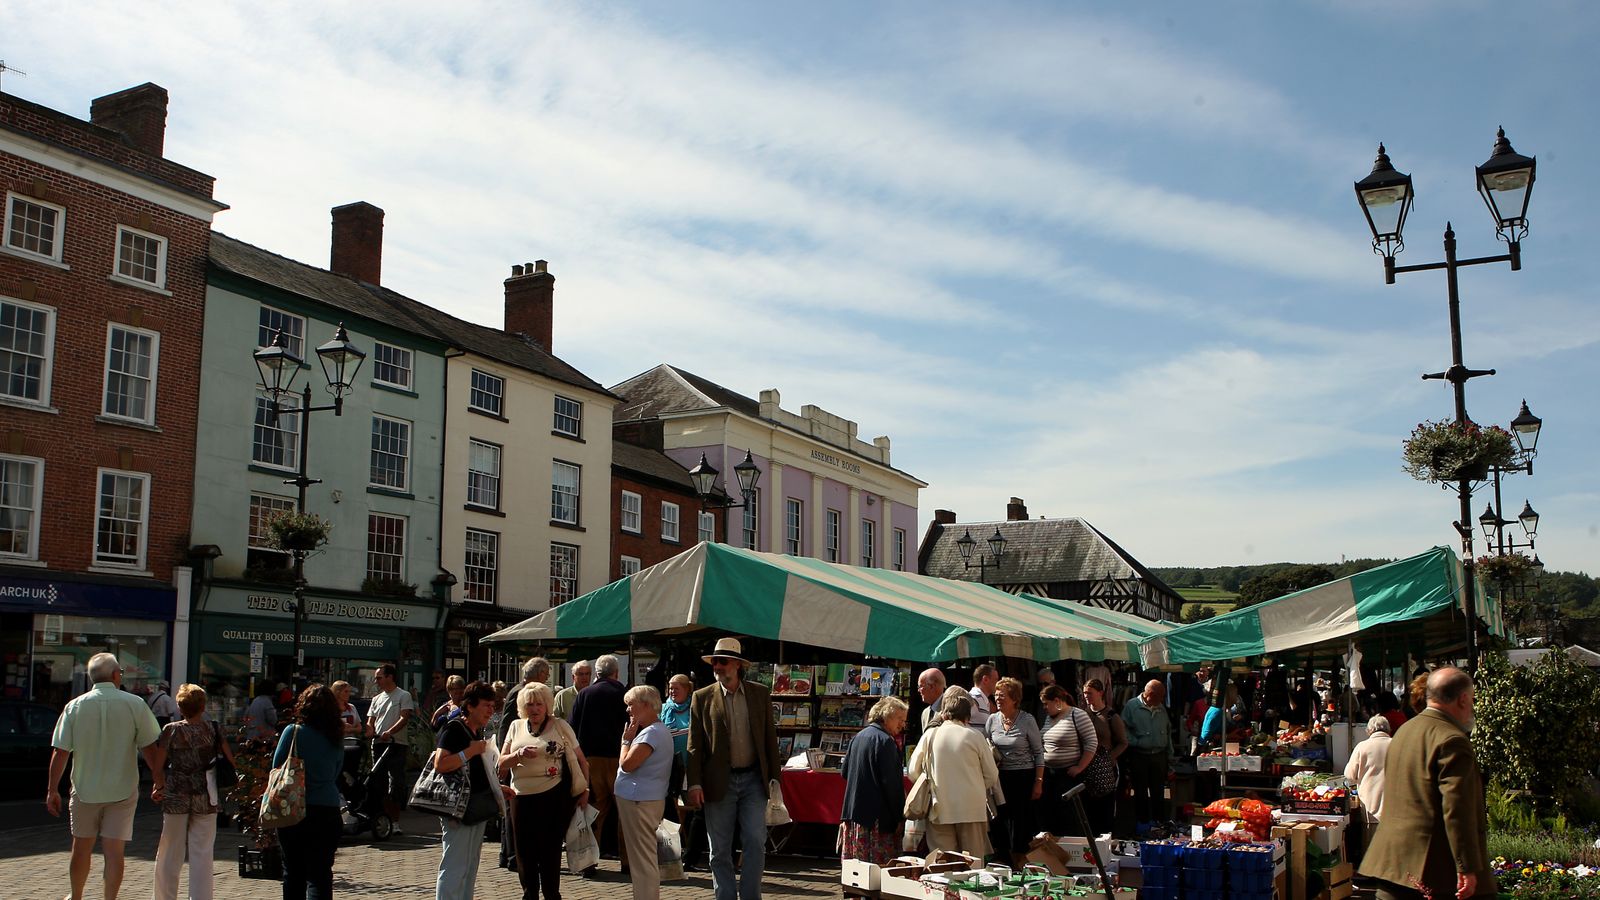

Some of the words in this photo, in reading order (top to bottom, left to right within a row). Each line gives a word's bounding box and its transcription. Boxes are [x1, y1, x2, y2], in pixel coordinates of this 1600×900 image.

[811, 450, 840, 466] ASSEMBLY
[841, 460, 860, 473] ROOMS
[0, 586, 29, 597] ARCH
[31, 588, 47, 599] UK
[248, 595, 279, 611] THE
[282, 597, 336, 616] CTLE
[337, 603, 410, 622] BOOKSHOP
[223, 630, 263, 640] QUALITY
[265, 632, 326, 644] BOOKSLLERS
[328, 636, 334, 645] &
[336, 636, 384, 648] STATIONERS
